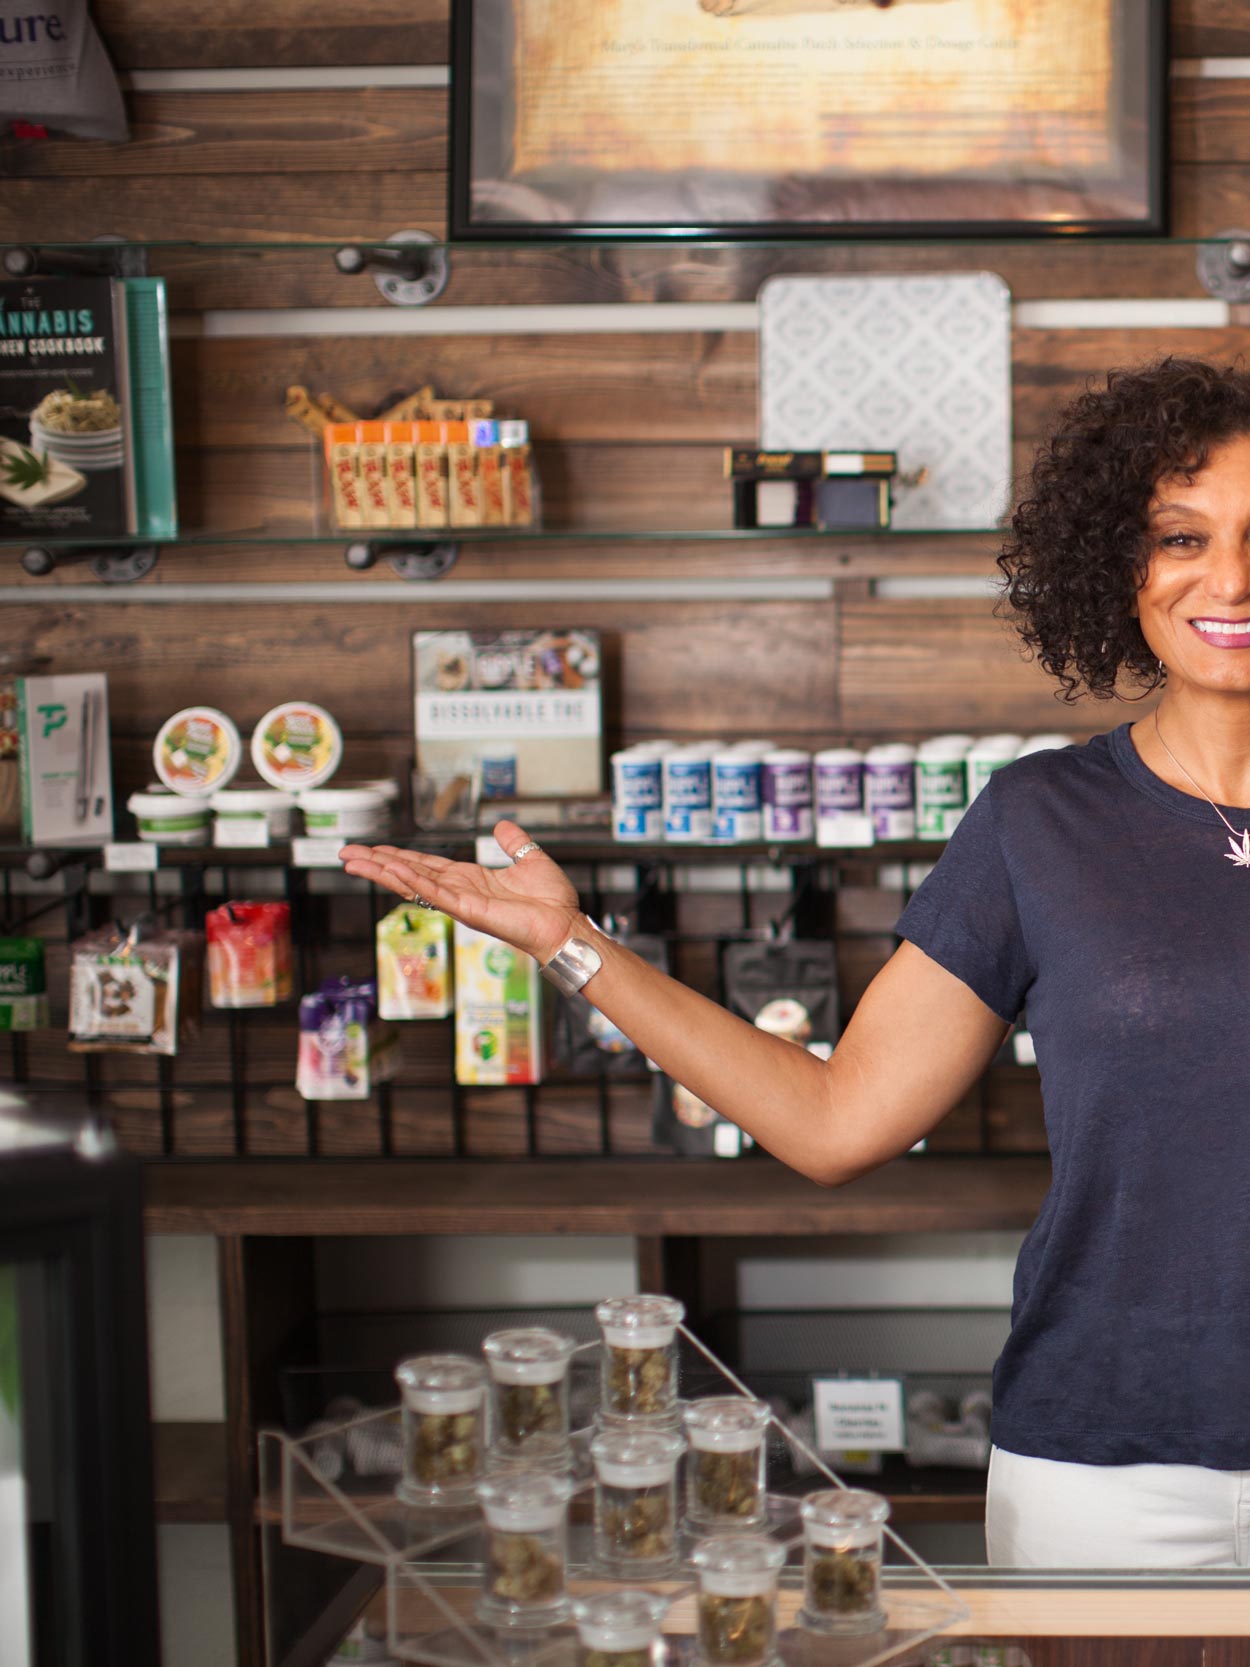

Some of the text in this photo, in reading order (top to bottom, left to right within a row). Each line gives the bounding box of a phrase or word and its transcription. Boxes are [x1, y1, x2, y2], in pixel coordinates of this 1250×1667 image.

[28, 336, 105, 356] COOKBOOK
[430, 702, 584, 720] DISSOLVABLE THC
